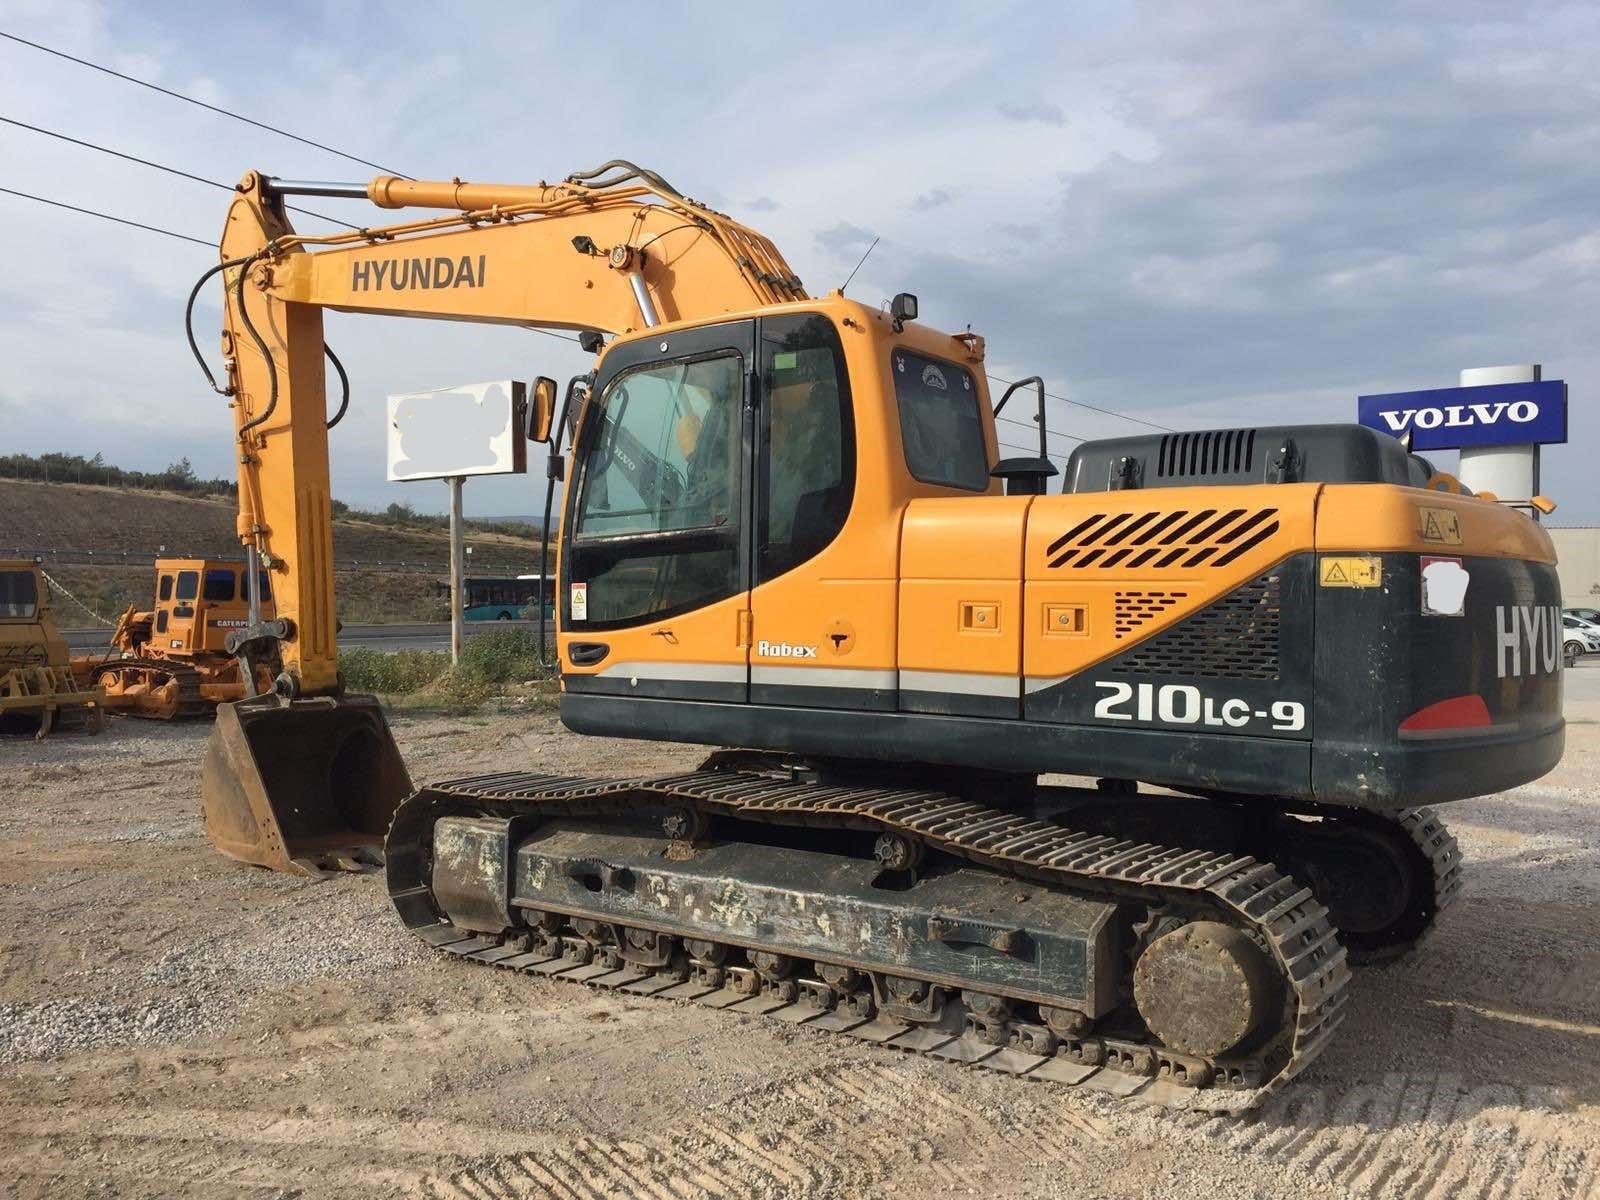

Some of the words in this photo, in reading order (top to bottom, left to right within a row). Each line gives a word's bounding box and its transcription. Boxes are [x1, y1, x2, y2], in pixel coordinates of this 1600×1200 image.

[352, 255, 486, 291] HYUNDAI
[1379, 400, 1539, 431] VOLVO
[758, 640, 817, 657] Robex
